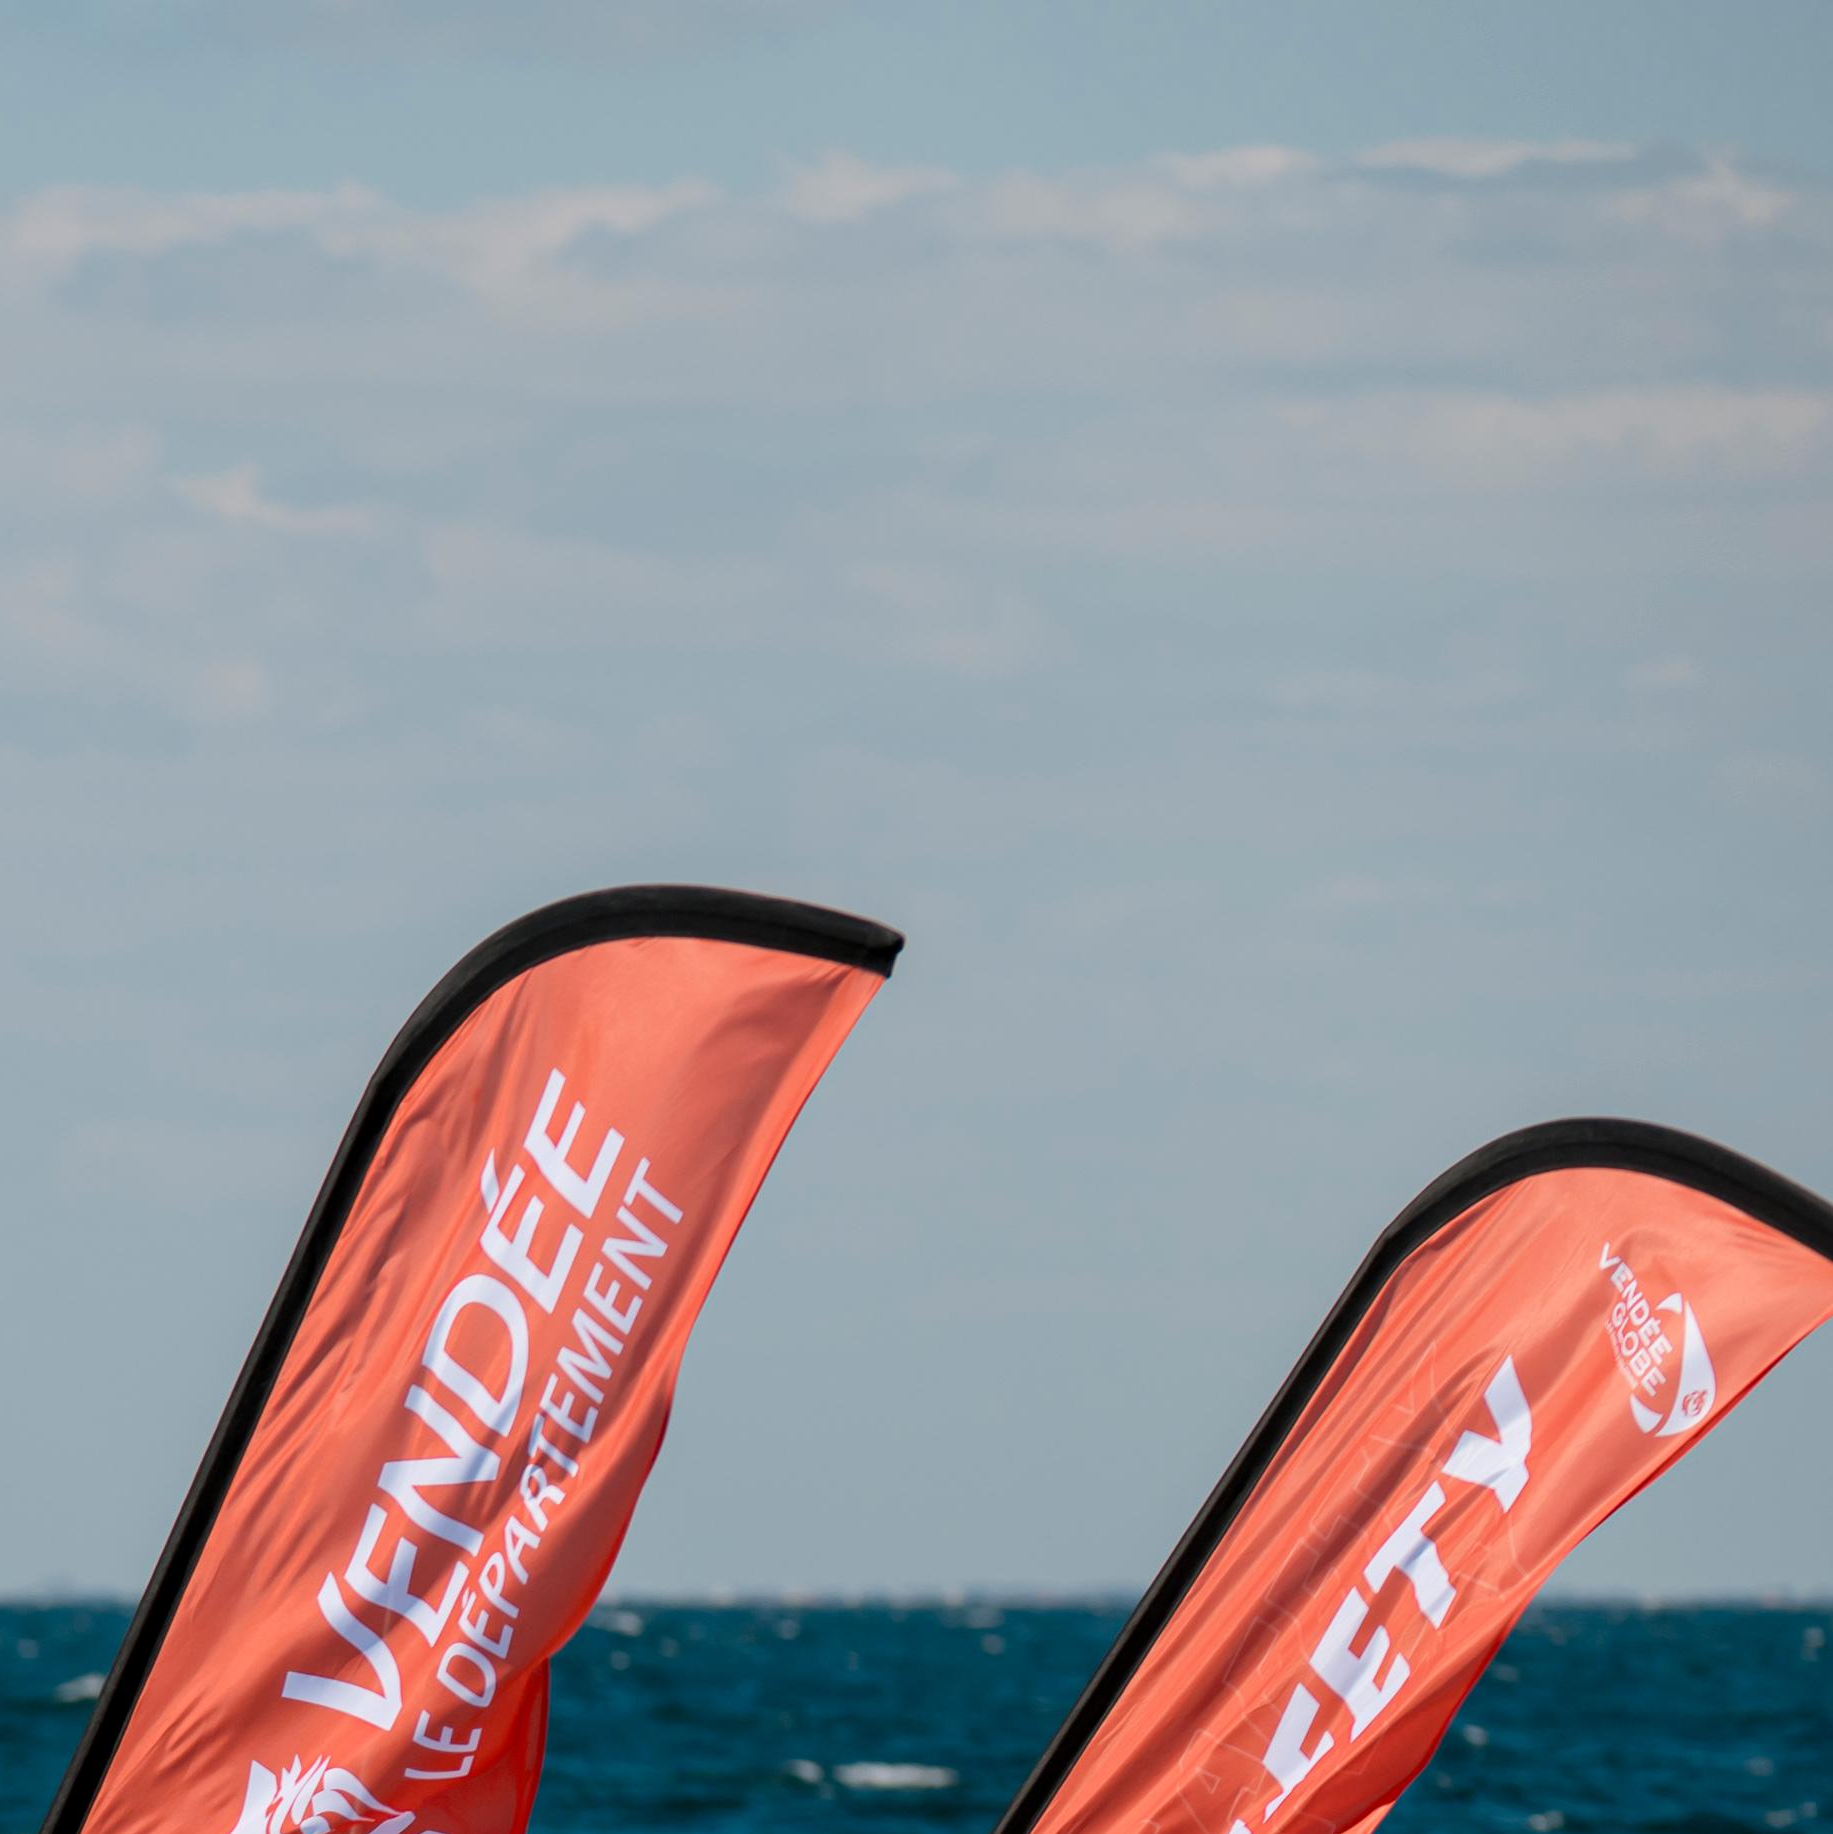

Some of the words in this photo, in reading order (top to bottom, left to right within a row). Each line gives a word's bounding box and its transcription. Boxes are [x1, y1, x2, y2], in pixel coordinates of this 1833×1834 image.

[1598, 1241, 1673, 1365] VENDÉE
[1611, 1301, 1666, 1397] GLOBE
[282, 1068, 625, 1731] VENDÉE
[436, 1158, 684, 1708] DÉPARTEMENT
[405, 1710, 481, 1780] LE
